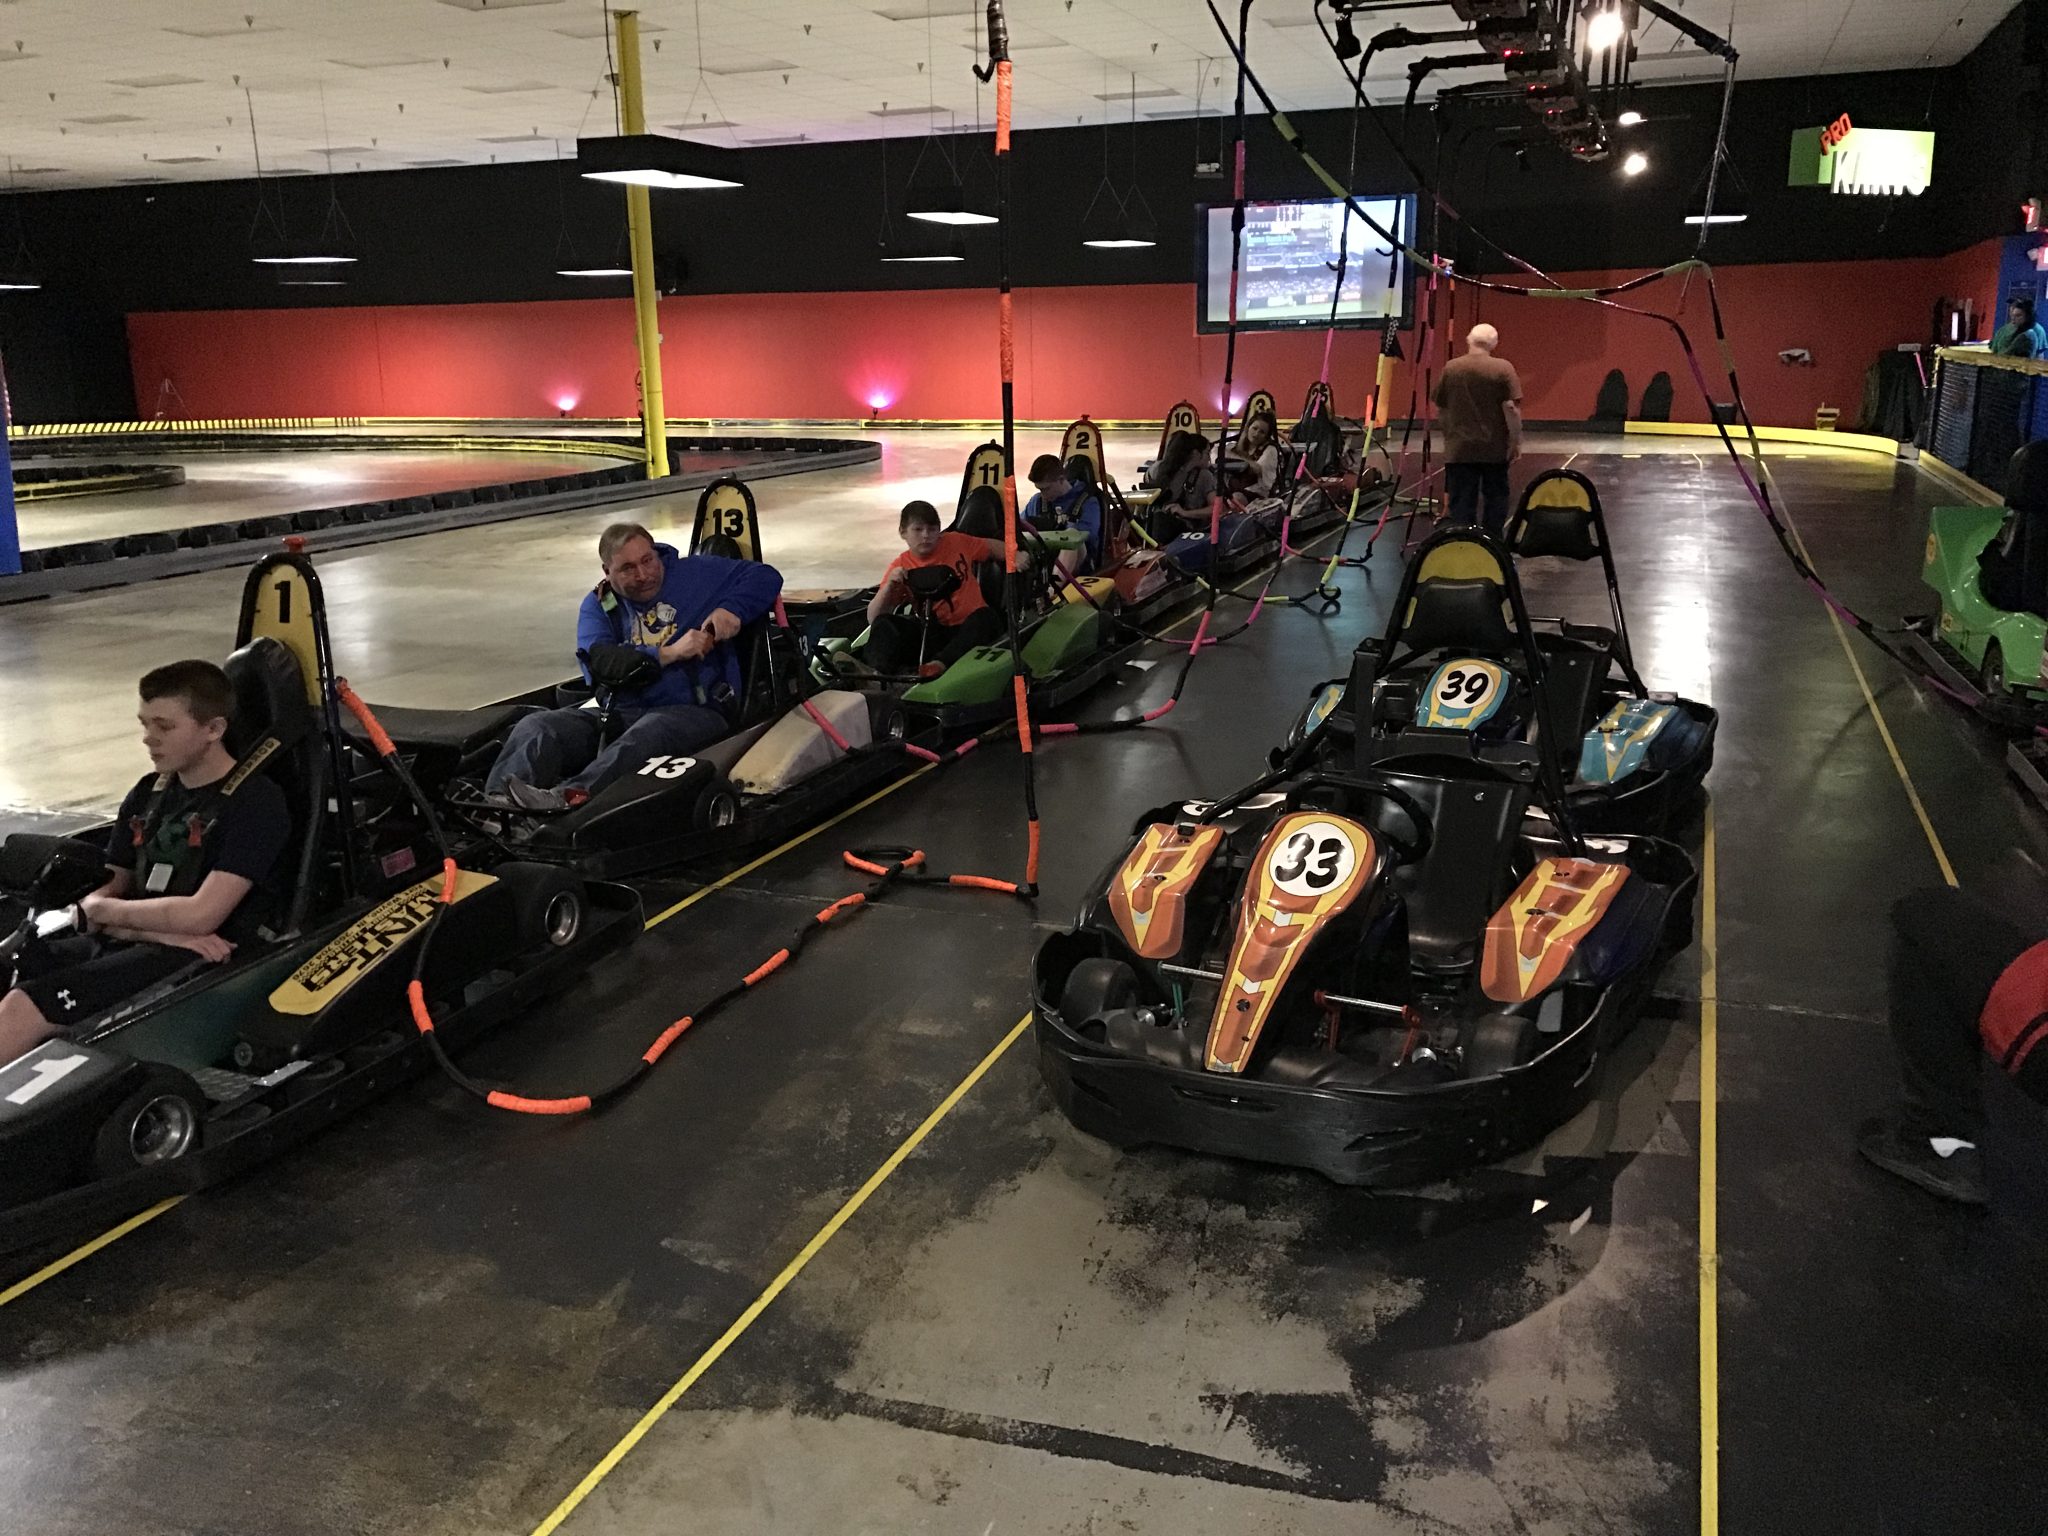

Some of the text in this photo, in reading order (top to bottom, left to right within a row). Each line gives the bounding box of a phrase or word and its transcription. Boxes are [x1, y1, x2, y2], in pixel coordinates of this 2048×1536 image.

[1820, 112, 1852, 156] PRO
[1831, 150, 1926, 196] KAS
[1174, 412, 1193, 428] 10
[1076, 431, 1090, 450] 2
[979, 463, 999, 485] 11
[712, 508, 744, 538] 13
[1180, 531, 1205, 541] 10
[274, 580, 291, 623] 1
[974, 649, 1005, 662] 11
[1441, 670, 1489, 704] 39
[636, 755, 697, 779] 13
[1275, 833, 1345, 888] 33
[309, 892, 433, 984] MASTERS
[4, 1054, 90, 1106] 1
